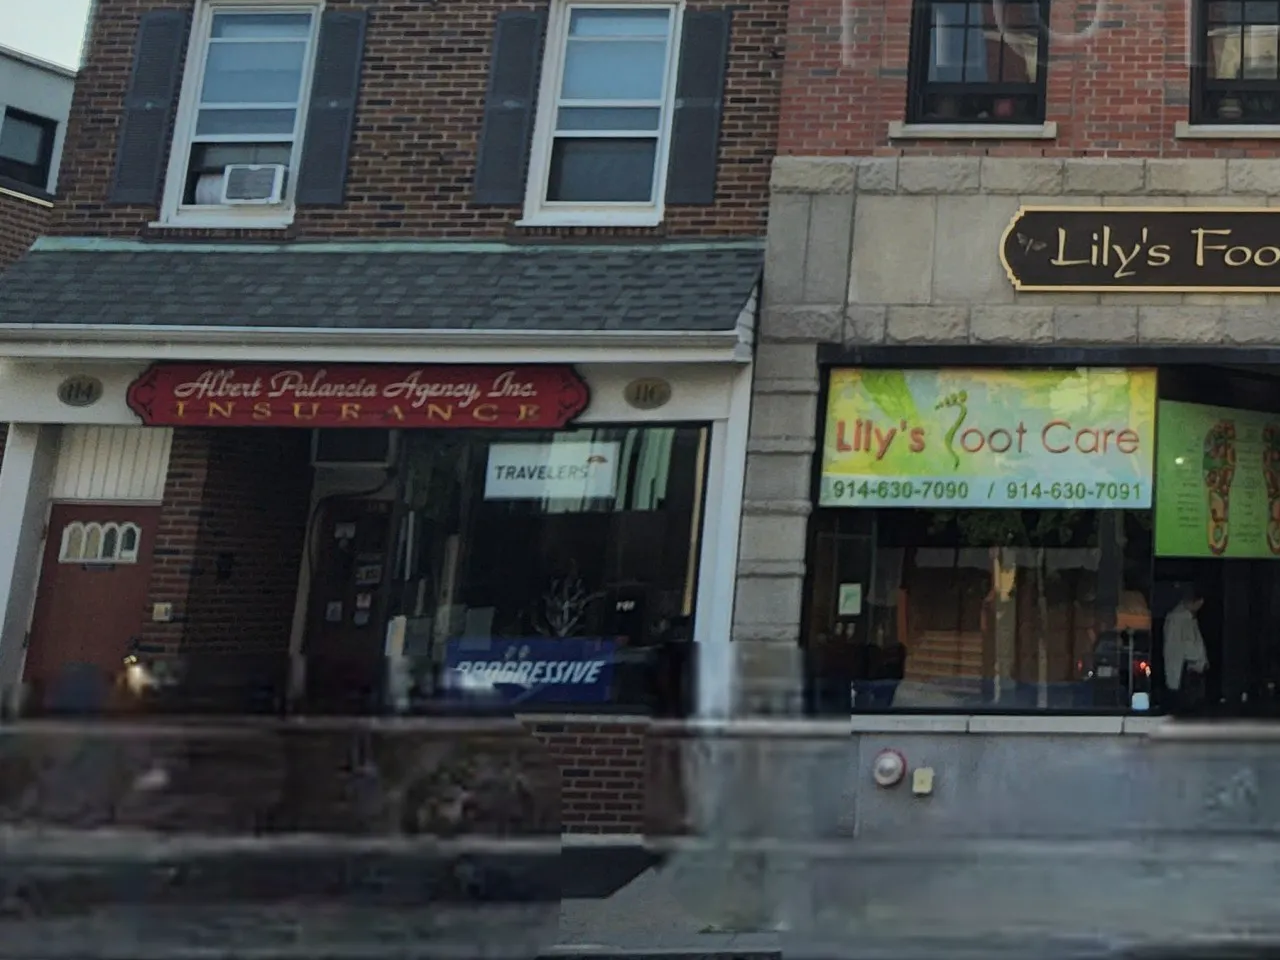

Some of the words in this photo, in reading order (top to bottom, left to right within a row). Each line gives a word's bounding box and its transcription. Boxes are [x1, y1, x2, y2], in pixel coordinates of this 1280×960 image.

[1050, 225, 1171, 278] Lily's
[174, 369, 262, 400] Albert
[268, 370, 377, 399] Palancia
[383, 369, 481, 408] Agency,
[487, 371, 538, 398] Inc.
[174, 401, 541, 421] INSURANCE
[834, 417, 926, 461] Lily's
[1041, 419, 1141, 455] Care
[493, 463, 590, 481] TRAVELERS
[833, 480, 969, 500] 914-630-7090
[1007, 481, 1141, 500] 914-630-7091
